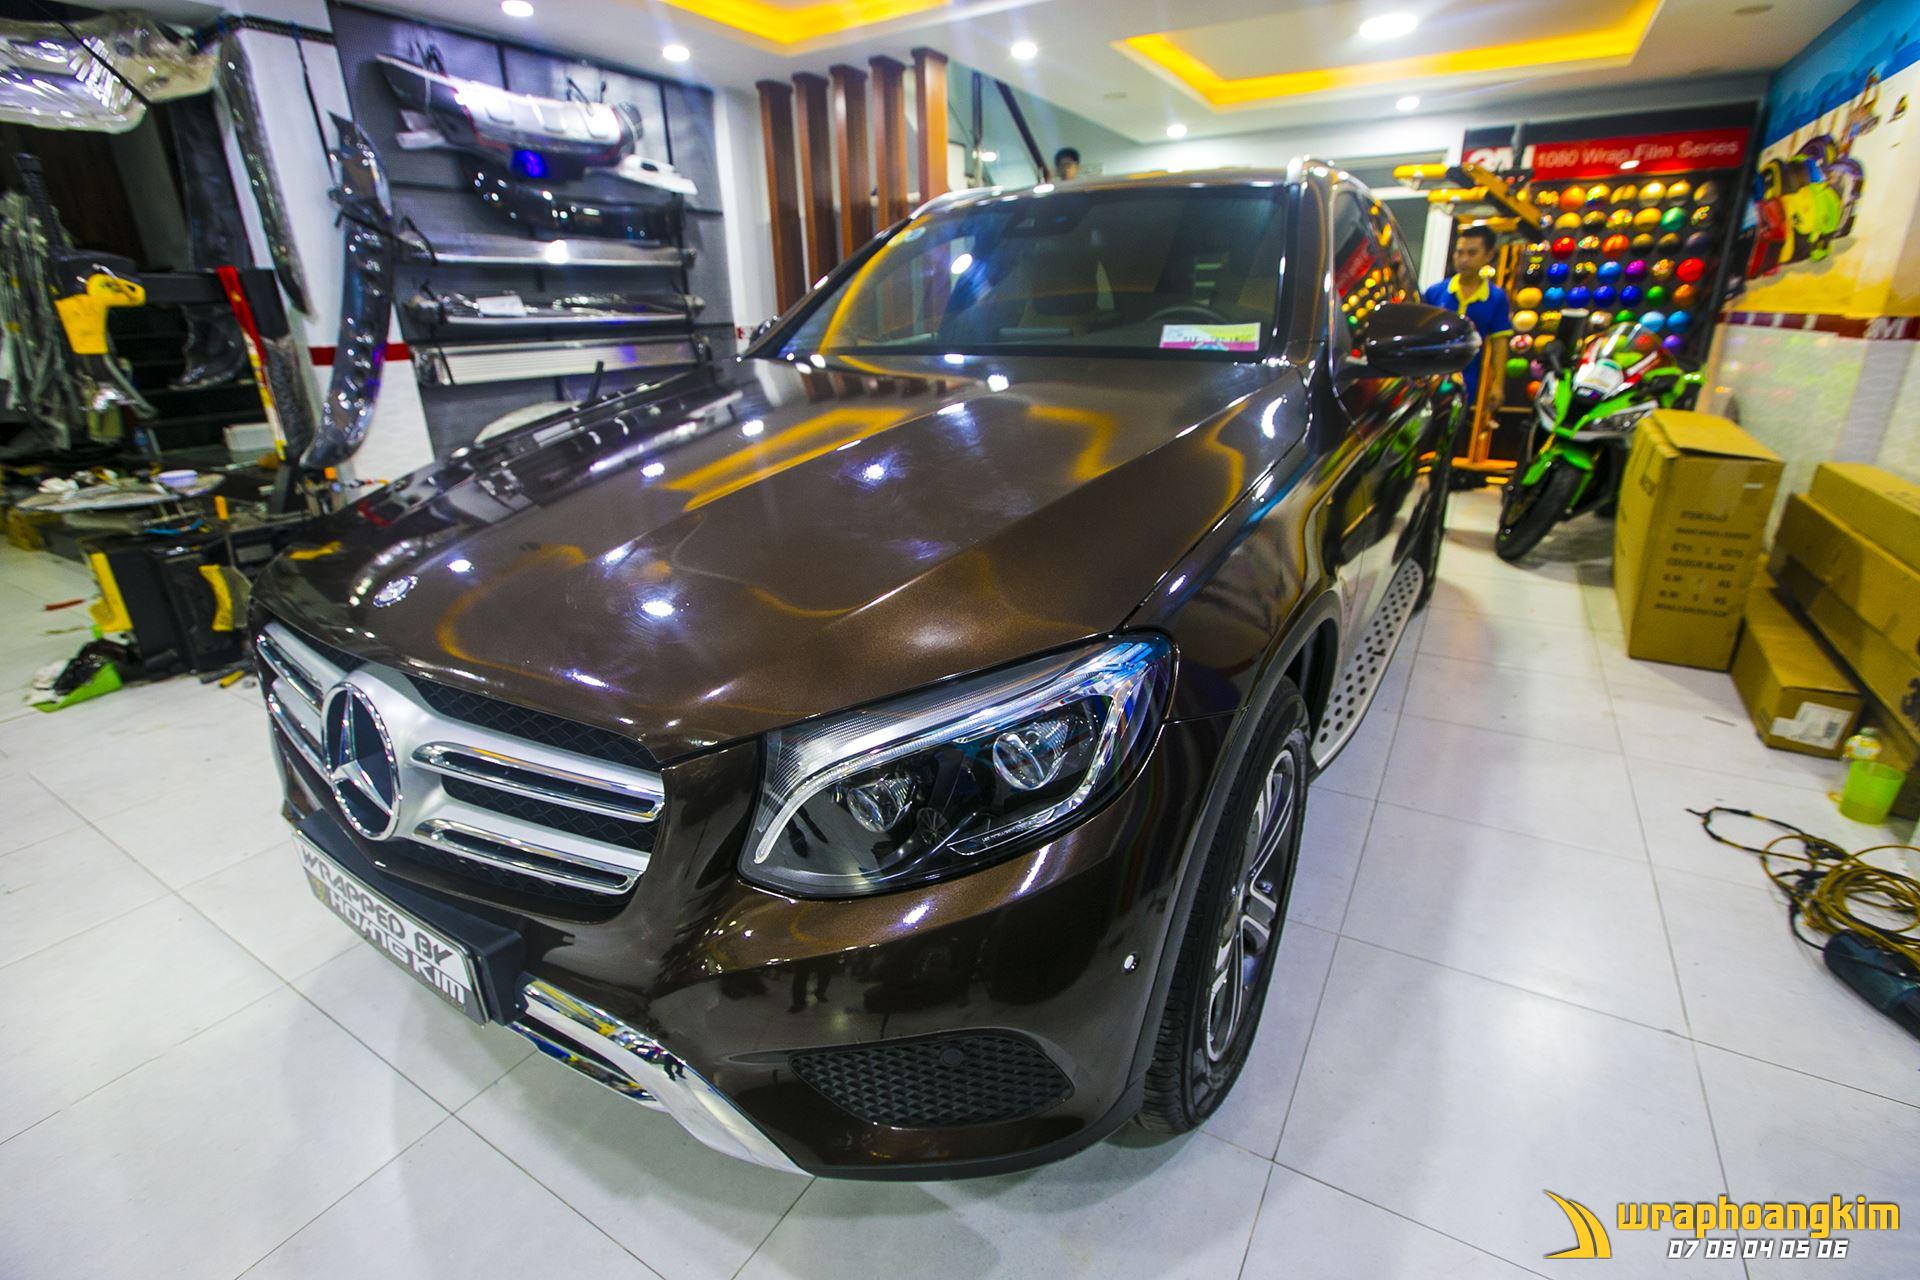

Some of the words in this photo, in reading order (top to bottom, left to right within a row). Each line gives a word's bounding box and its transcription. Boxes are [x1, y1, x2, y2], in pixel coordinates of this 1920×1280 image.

[1582, 146, 1631, 167] Wrap
[1632, 143, 1675, 161] Film
[1677, 140, 1739, 159] Series
[303, 849, 406, 939] WRAPPED
[414, 931, 453, 966] BY
